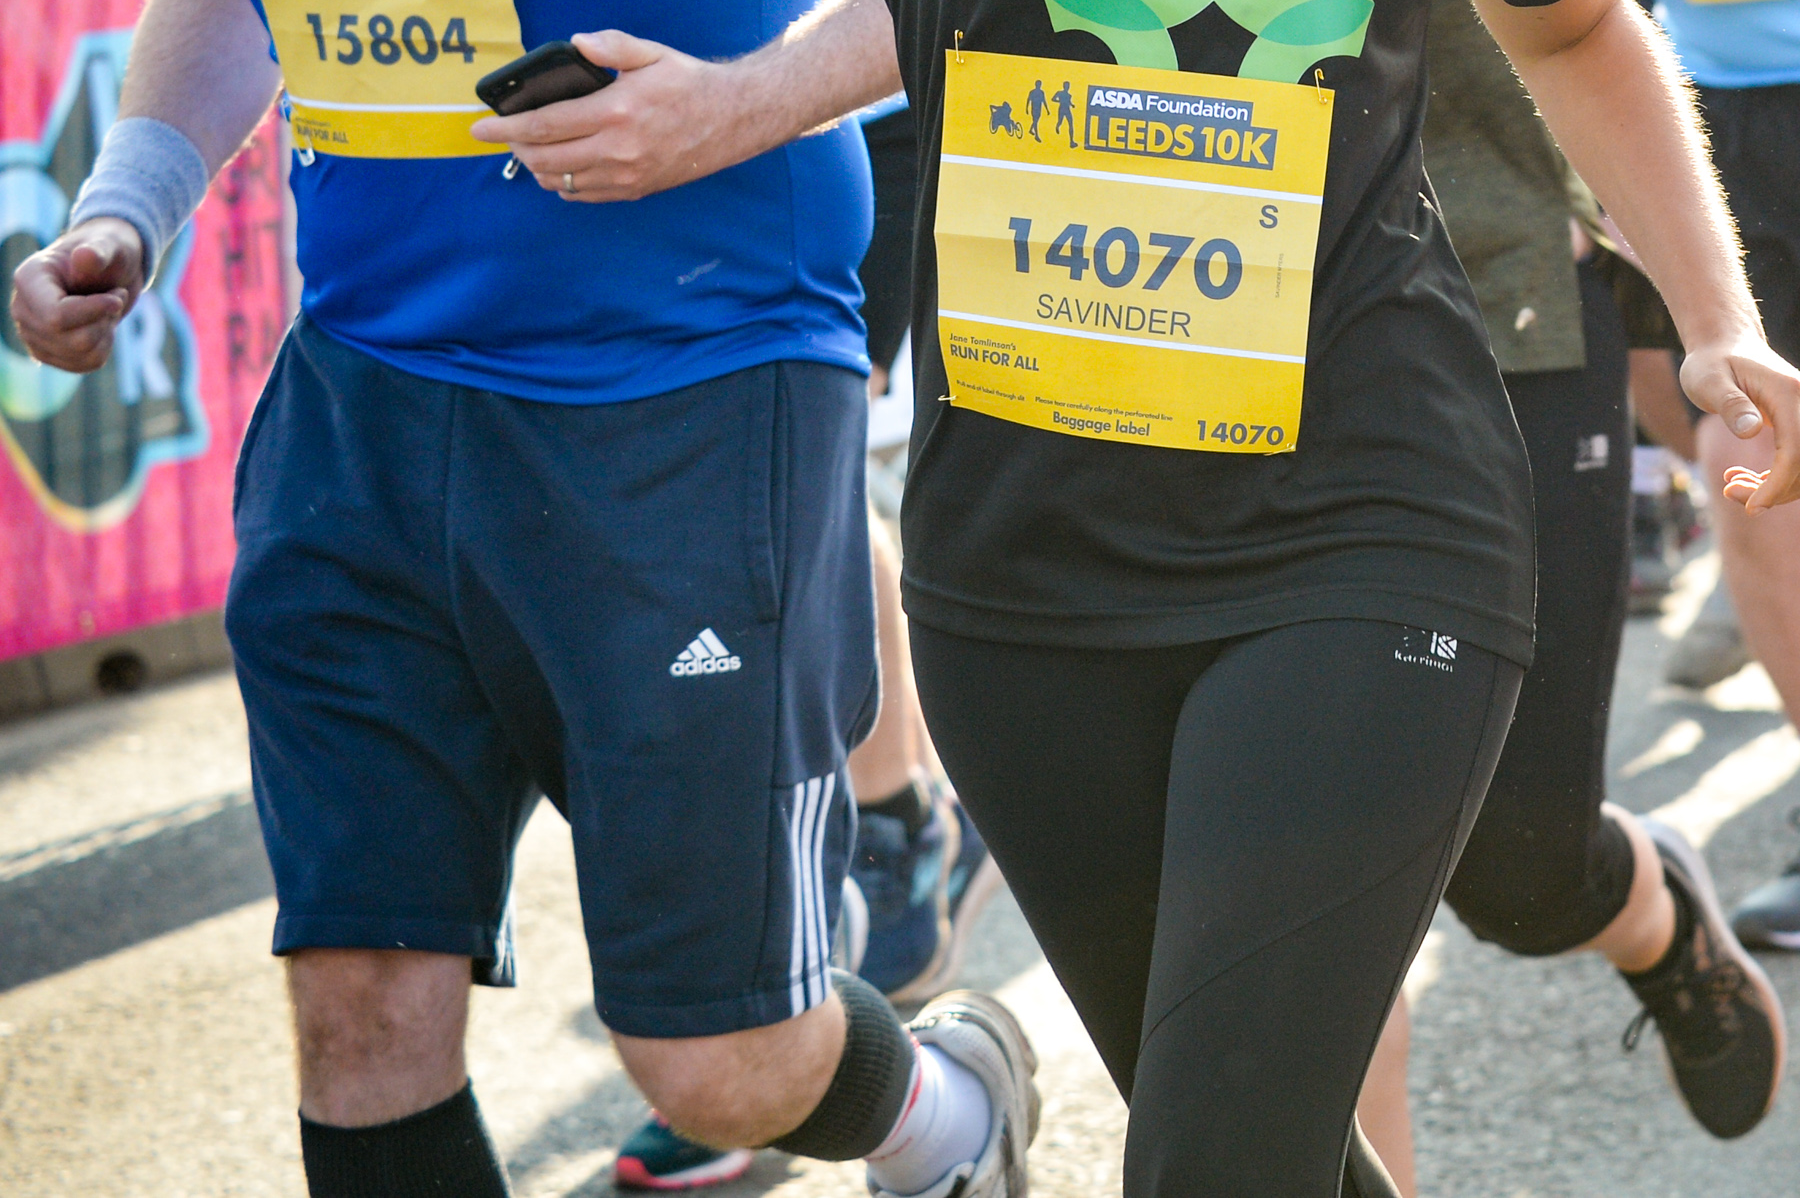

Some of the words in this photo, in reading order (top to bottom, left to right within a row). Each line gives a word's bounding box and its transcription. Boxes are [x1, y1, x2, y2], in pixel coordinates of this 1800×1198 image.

[306, 13, 478, 66] 15804
[1089, 88, 1144, 112] ASDA
[1145, 94, 1250, 122] Foundation
[1088, 114, 1195, 158] LEEDS
[1200, 125, 1272, 166] 10K
[1259, 204, 1279, 229] S
[1008, 216, 1244, 301] 14070
[1036, 293, 1192, 338] SAVINDER
[950, 332, 969, 344] Jane
[970, 335, 1017, 351] Tomlinson's
[950, 343, 979, 362] RUN
[982, 350, 1011, 368] FOR
[1013, 355, 1040, 372] ALL
[1035, 396, 1053, 405] Please
[1066, 402, 1093, 412] carefully
[1093, 405, 1112, 415] along
[1124, 410, 1160, 420] perforated
[1160, 413, 1174, 422] line
[1053, 411, 1112, 434] Baggage
[1116, 419, 1150, 437] label
[1197, 419, 1285, 446] 14070
[668, 654, 743, 678] adidas
